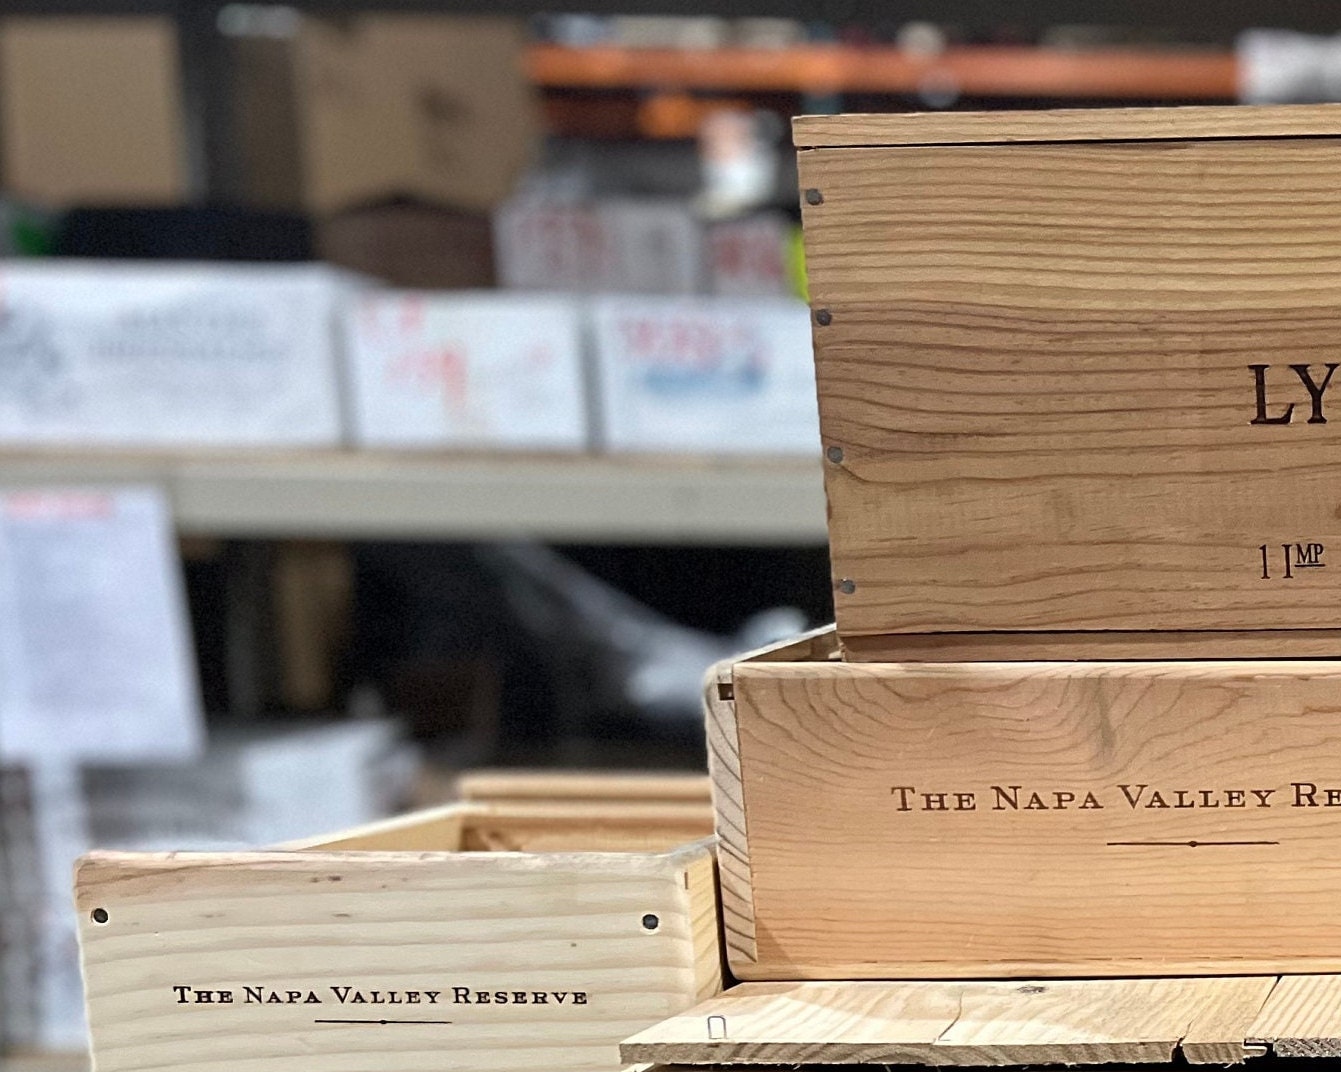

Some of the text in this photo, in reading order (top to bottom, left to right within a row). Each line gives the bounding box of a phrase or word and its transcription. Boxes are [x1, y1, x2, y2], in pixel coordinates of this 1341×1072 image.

[892, 786, 977, 812] THE
[992, 785, 1104, 811] NAPA
[1117, 784, 1276, 810] VALLEY
[173, 985, 588, 1005] THE NAPA VALLEY RESERVE
